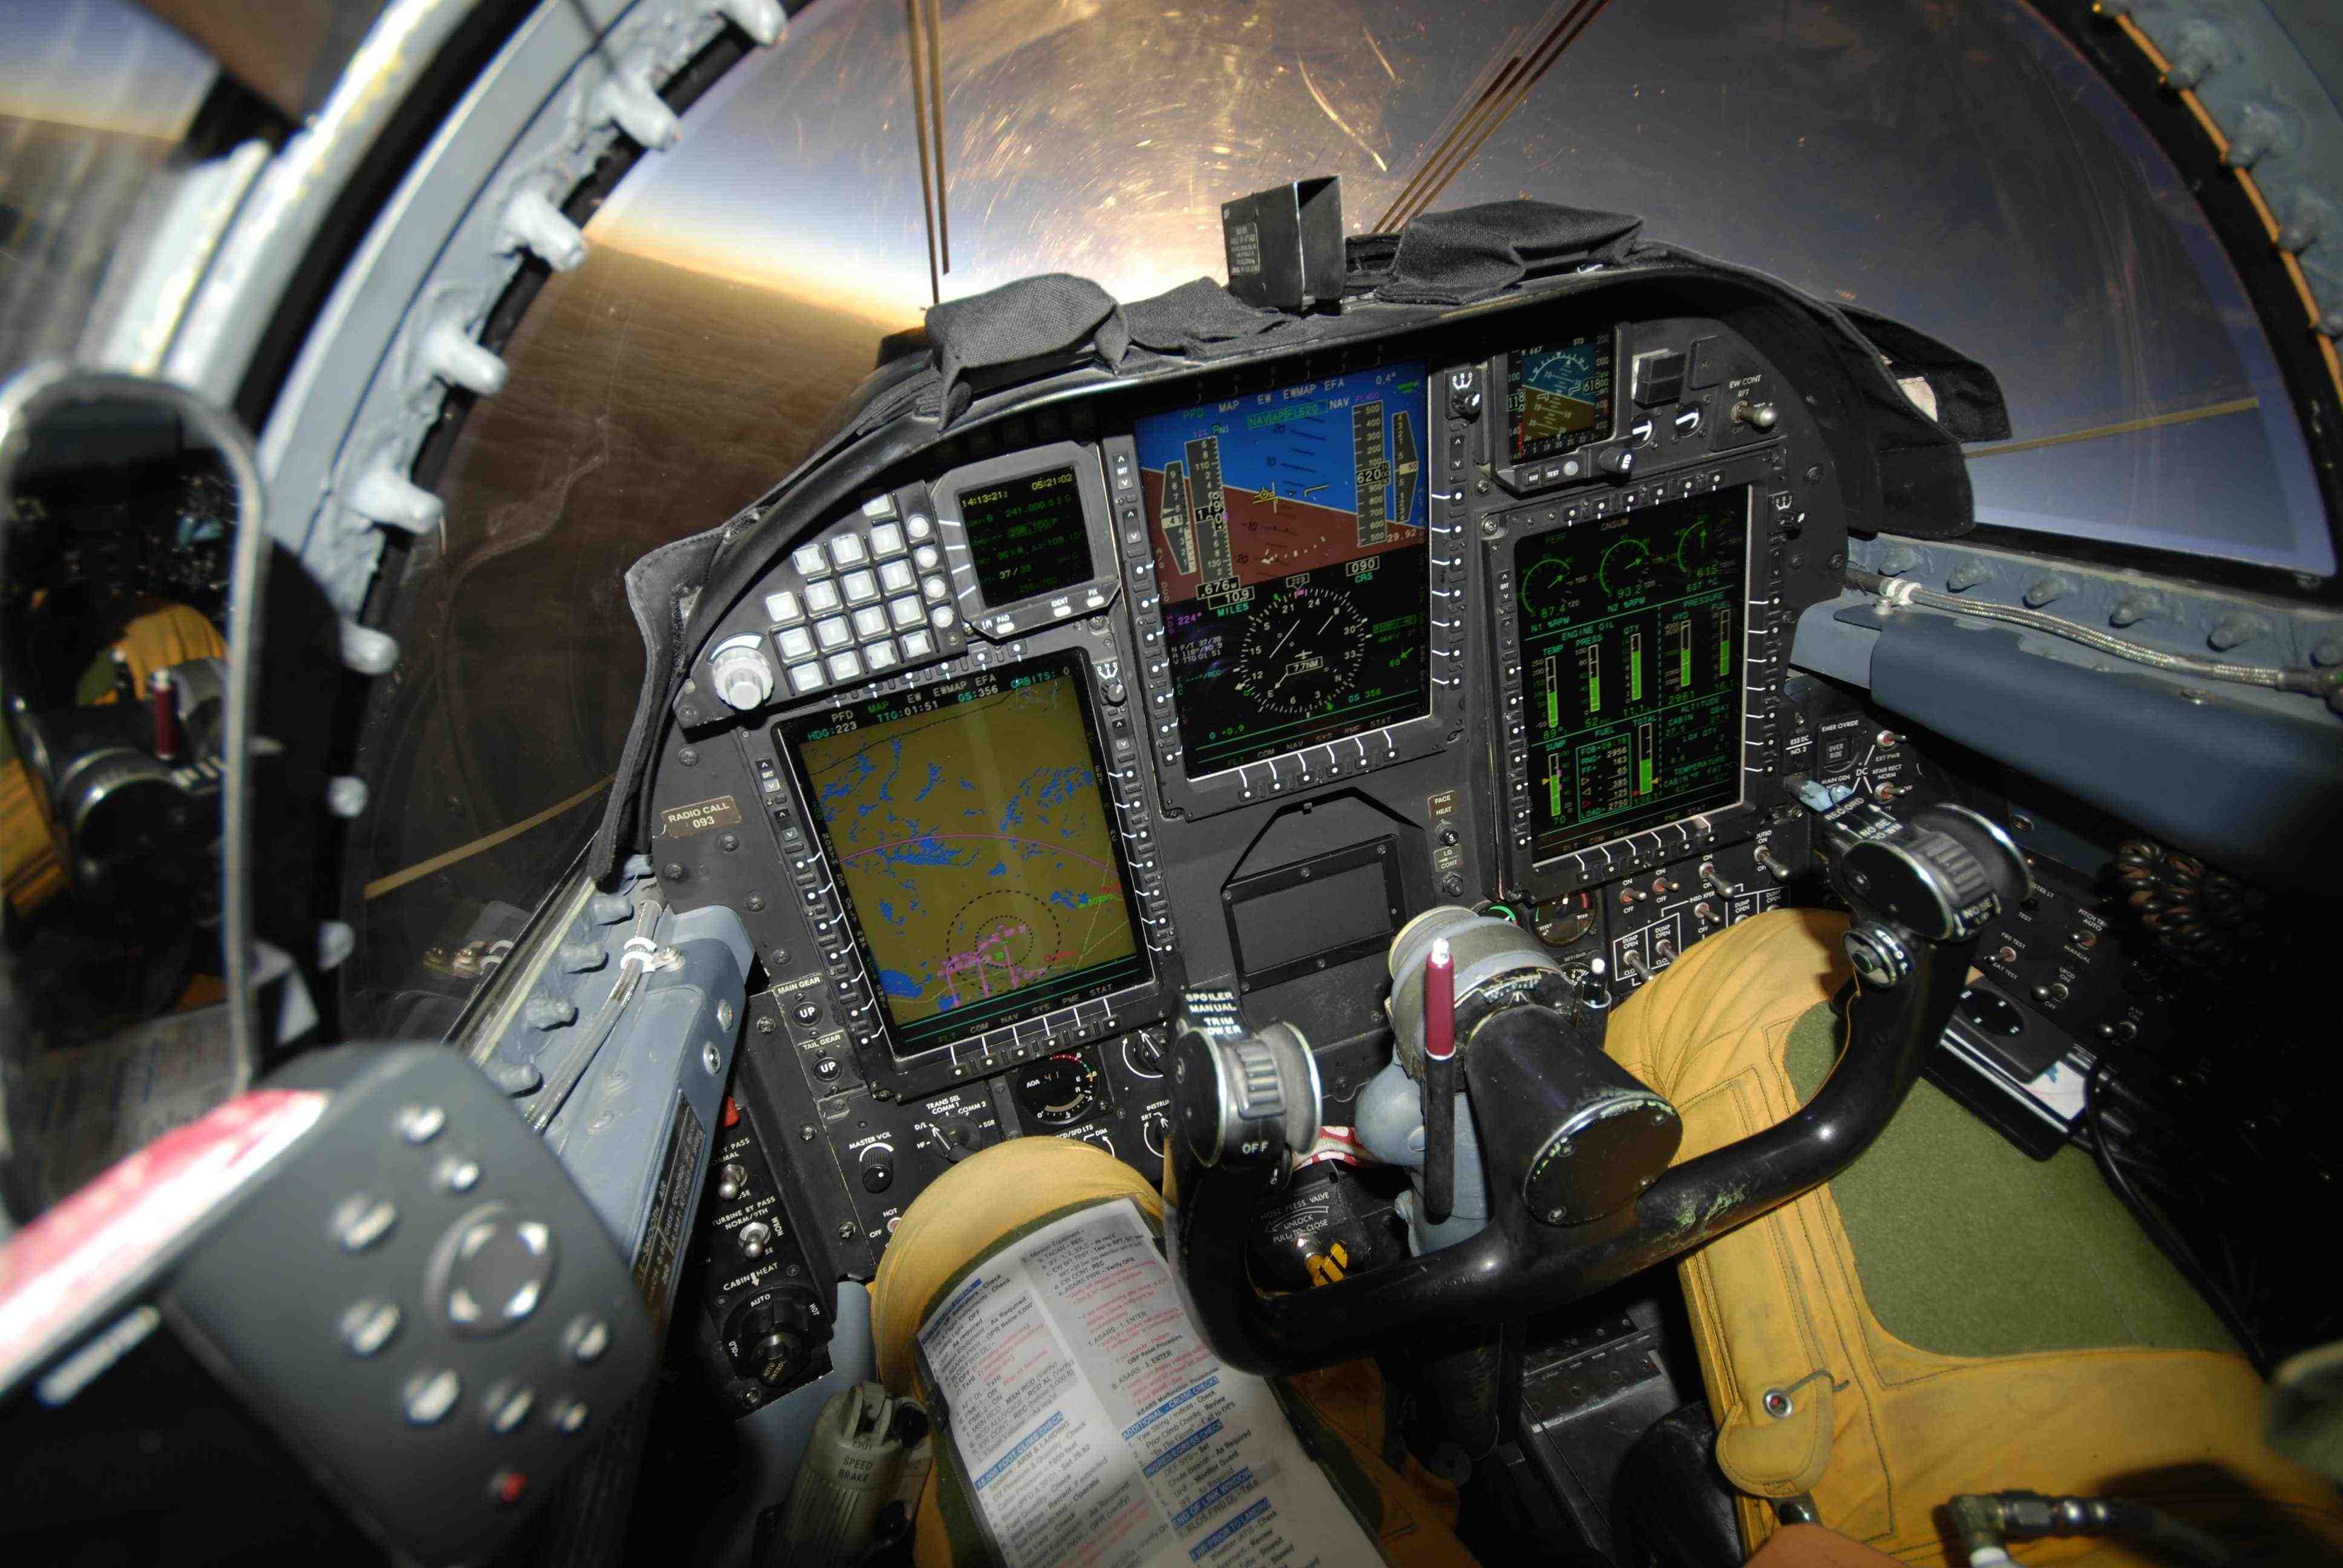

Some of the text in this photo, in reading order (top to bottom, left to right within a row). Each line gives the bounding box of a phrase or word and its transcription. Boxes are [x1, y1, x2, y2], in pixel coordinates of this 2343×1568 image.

[1729, 374, 1762, 389] EW CONT
[1219, 400, 1239, 413] MAP
[1257, 394, 1271, 405] EW
[1283, 384, 1316, 399] EWMAP
[1324, 378, 1345, 391] EFA
[1329, 397, 1349, 410] NAV
[1547, 469, 1559, 479] TEST
[1351, 558, 1375, 573] 090
[1355, 572, 1373, 583] CRS
[1683, 591, 1724, 609] PRESSURE
[1217, 602, 1250, 618] MILES
[1561, 621, 1614, 641] ENGINE OIL
[1623, 624, 1640, 635] QTY
[1575, 634, 1604, 647] PRESS
[1543, 644, 1564, 656] TEMP
[831, 673, 997, 723] PFD MAP EW EWMAP EFA
[1365, 688, 1381, 698] 356
[1680, 696, 1720, 713] ALTITUDE
[1633, 715, 1657, 724] TOTAL
[1668, 713, 1694, 726] CABIN
[1821, 719, 1860, 733] EMER OVRIDE
[1594, 727, 1614, 737] FUEL
[1545, 740, 1567, 751] SUMP
[1790, 736, 1801, 745] ESS
[1829, 743, 1844, 753] OVER
[1829, 751, 1843, 759] RIDE
[1855, 767, 1869, 777] DC
[1887, 763, 1902, 773] RECT
[1821, 774, 1851, 785] MAIN GEN
[1878, 772, 1897, 780] NORM
[1434, 794, 1451, 805] FACE
[668, 802, 730, 823] RADIO CALL
[1435, 806, 1452, 816] HEAT
[1824, 797, 1866, 821] RECORD
[692, 815, 715, 829] 093
[1703, 853, 1713, 861] ON
[1440, 860, 1458, 869] CONT
[1656, 867, 1666, 876] ON
[1656, 895, 1667, 904] OFF
[1734, 899, 1750, 909] DUMP
[1623, 905, 1634, 914] OFF
[1735, 904, 1751, 913] OPEN
[2077, 907, 2097, 921] PITCH
[2018, 910, 2033, 923] TEST
[1655, 924, 1670, 933] DUMP
[1697, 926, 1709, 934] OFF
[2082, 918, 2103, 932] AUTO
[1622, 935, 1639, 944] DUMP
[1655, 930, 1671, 939] OPEN
[1623, 940, 1639, 949] OPEN
[2013, 937, 2027, 950] TEST
[2062, 944, 2092, 965] MANUAL
[2005, 967, 2019, 980] TEST
[777, 976, 821, 995] MAIN GEAR
[1089, 984, 1113, 996] STAT
[1185, 990, 1234, 1002] SPOILER
[799, 1007, 816, 1019] UP
[1189, 1002, 1237, 1013] MANUAL
[1203, 1016, 1235, 1028] TRIM
[802, 1034, 842, 1051] TAIL GEAR
[820, 1061, 836, 1074] UP
[1026, 1078, 1041, 1089] AOA
[926, 1094, 962, 1111] TRANS SEL
[931, 1103, 955, 1115] COMM
[957, 1104, 980, 1115] COMM
[1141, 1112, 1153, 1121] BRT
[914, 1122, 928, 1131] D/L
[1083, 1123, 1094, 1132] LTS
[1095, 1127, 1108, 1137] DIM
[730, 1137, 751, 1150] PASS
[848, 1131, 893, 1150] MASTER VOL
[1241, 1140, 1270, 1155] OFF
[1309, 1191, 1330, 1203] VALVE
[745, 1195, 776, 1213] BY PASS
[882, 1207, 898, 1218] HOT
[771, 1216, 784, 1236] NORM
[1283, 1214, 1314, 1229] UNLOCK
[869, 1229, 883, 1239] OFF
[1069, 1236, 1084, 1249] REC
[1091, 1260, 1106, 1270] REC
[723, 1262, 779, 1291] CABIN HEAT
[982, 1273, 1002, 1290] Check
[991, 1278, 1012, 1293] Check
[750, 1293, 771, 1308] AUTO
[808, 1302, 821, 1316] HOT
[998, 1296, 1028, 1319] Required
[968, 1308, 981, 1322] OFF
[1125, 1310, 1148, 1326] ENTER
[1150, 1349, 1173, 1365] ENTER
[986, 1387, 998, 1399] ON
[1168, 1389, 1193, 1409] CRUISE
[991, 1394, 1003, 1406] ON
[1161, 1423, 1180, 1439] Climb
[1204, 1396, 1227, 1412] Review
[1038, 1422, 1070, 1448] LANDING
[1223, 1429, 1252, 1449] Required
[842, 1456, 873, 1471] SPEED
[1193, 1451, 1240, 1483] Monitor Guard
[837, 1468, 870, 1483] BRAKE
[1072, 1478, 1101, 1502] Operate
